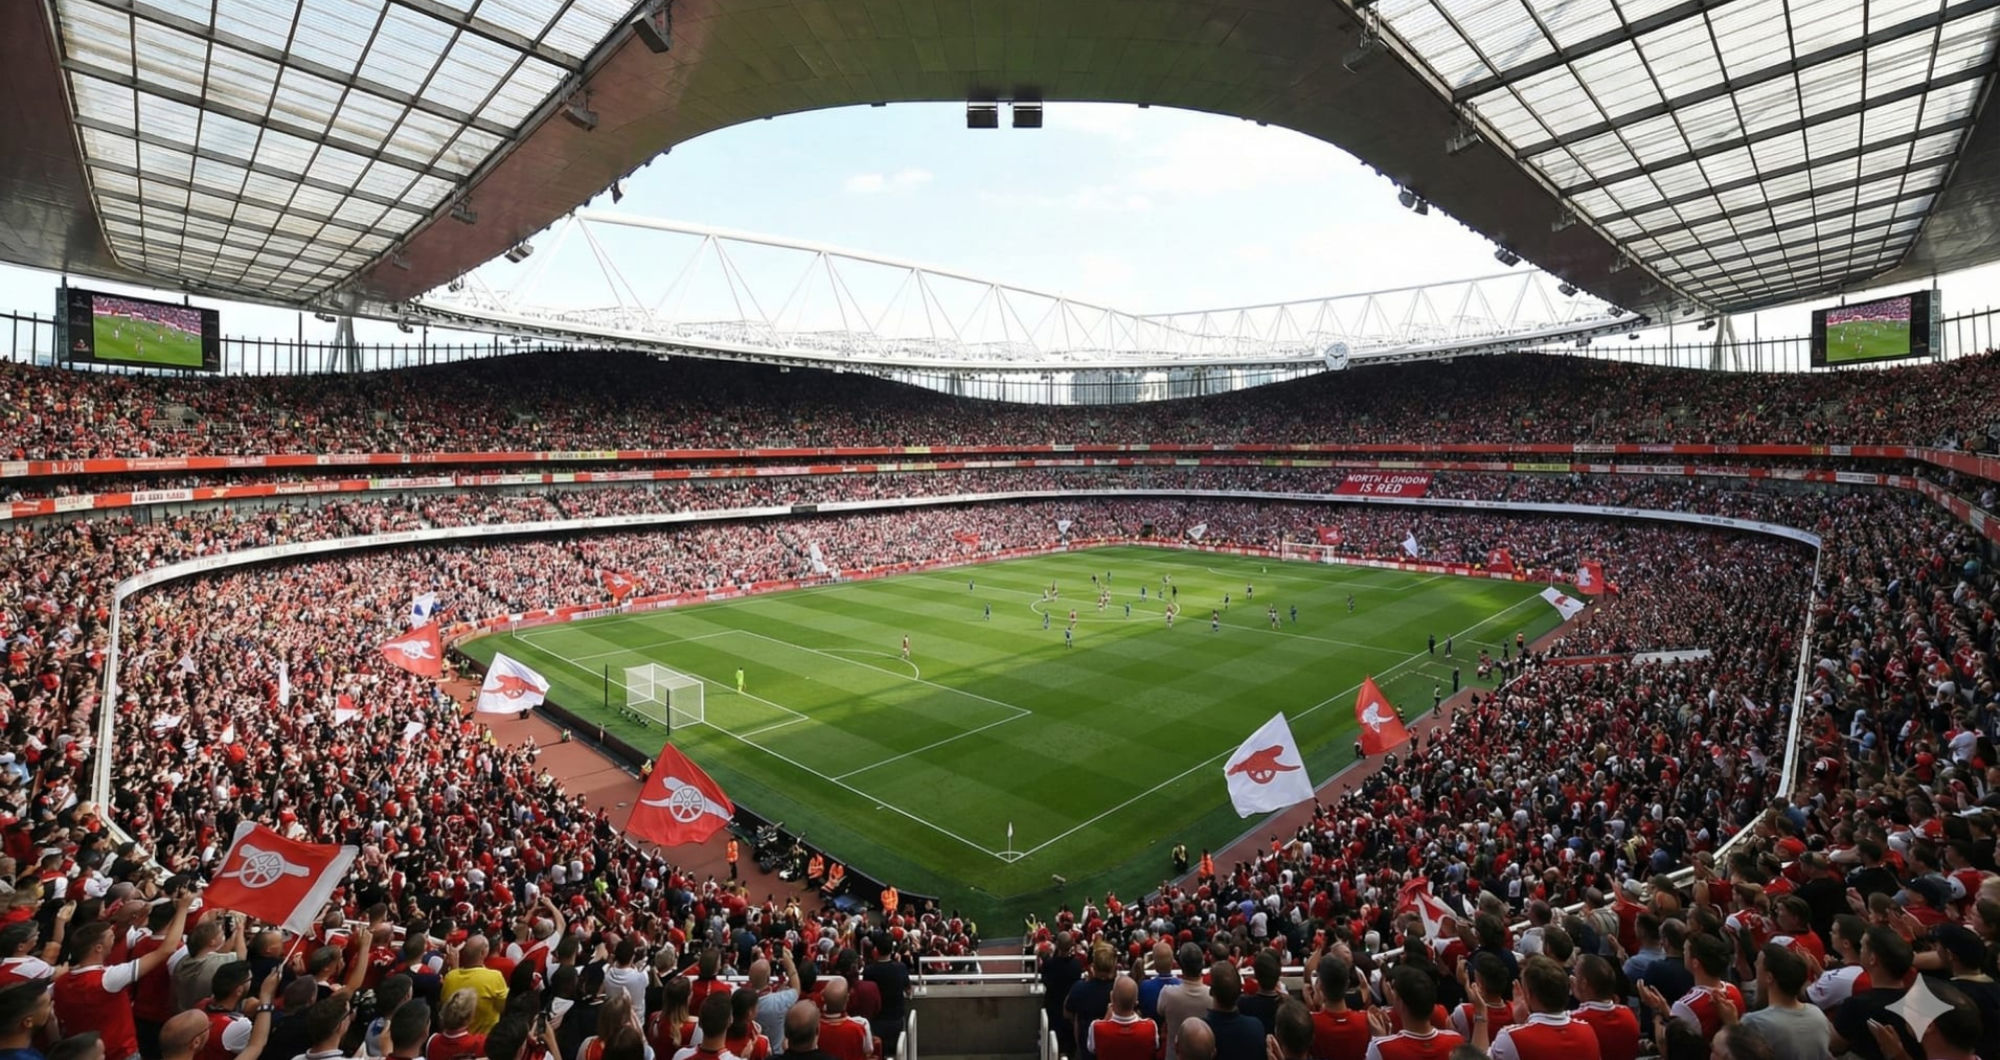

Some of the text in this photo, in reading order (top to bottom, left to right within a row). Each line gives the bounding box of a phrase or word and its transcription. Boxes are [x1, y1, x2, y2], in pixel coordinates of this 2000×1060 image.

[1348, 474, 1428, 485] NORTH LONDON
[1360, 483, 1403, 494] IS RED
